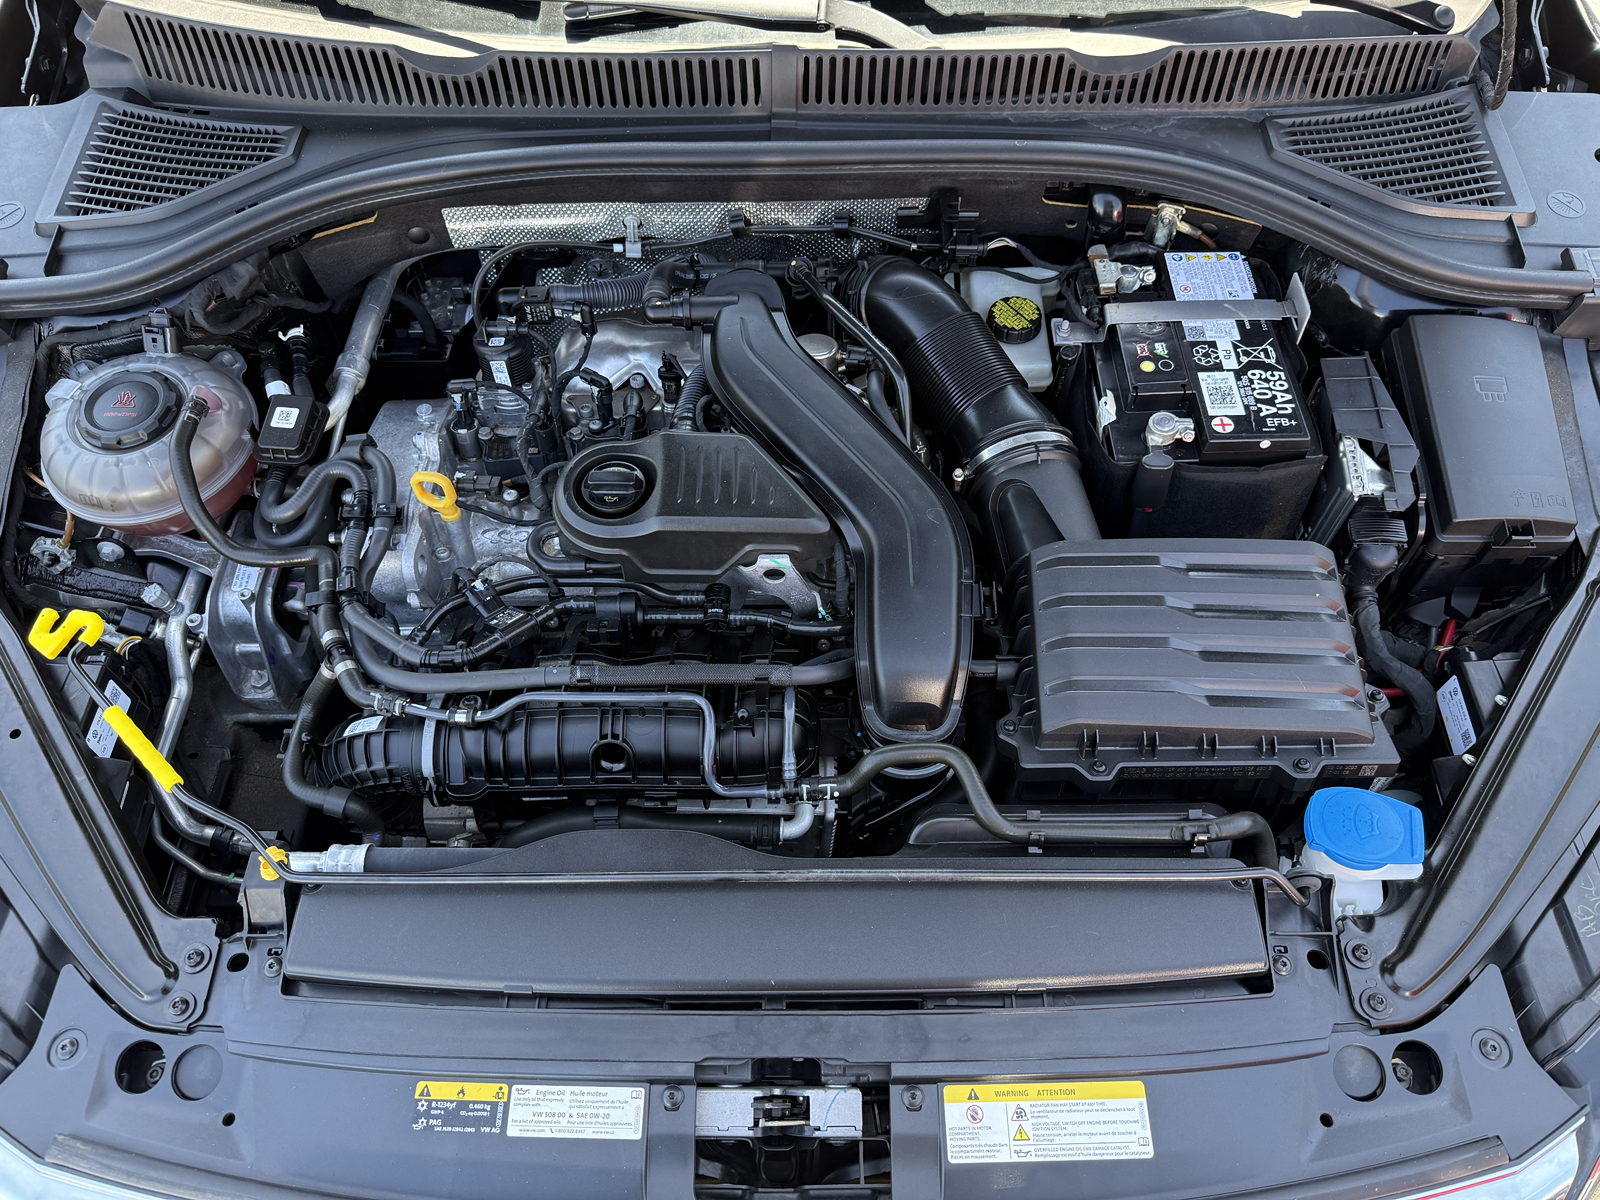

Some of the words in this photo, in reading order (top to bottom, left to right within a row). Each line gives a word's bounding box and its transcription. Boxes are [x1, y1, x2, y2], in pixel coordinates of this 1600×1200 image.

[1223, 349, 1232, 360] Pb
[1247, 369, 1267, 399] 640
[1257, 405, 1278, 417] A
[1266, 370, 1296, 414] 59Ah
[1266, 418, 1297, 426] EFB+
[536, 1089, 556, 1097] Engine
[994, 1090, 1029, 1098] WARNING
[1037, 1088, 1076, 1097] ATTENTION
[432, 1101, 456, 1109] R-1234yf
[484, 1103, 491, 1111] kg
